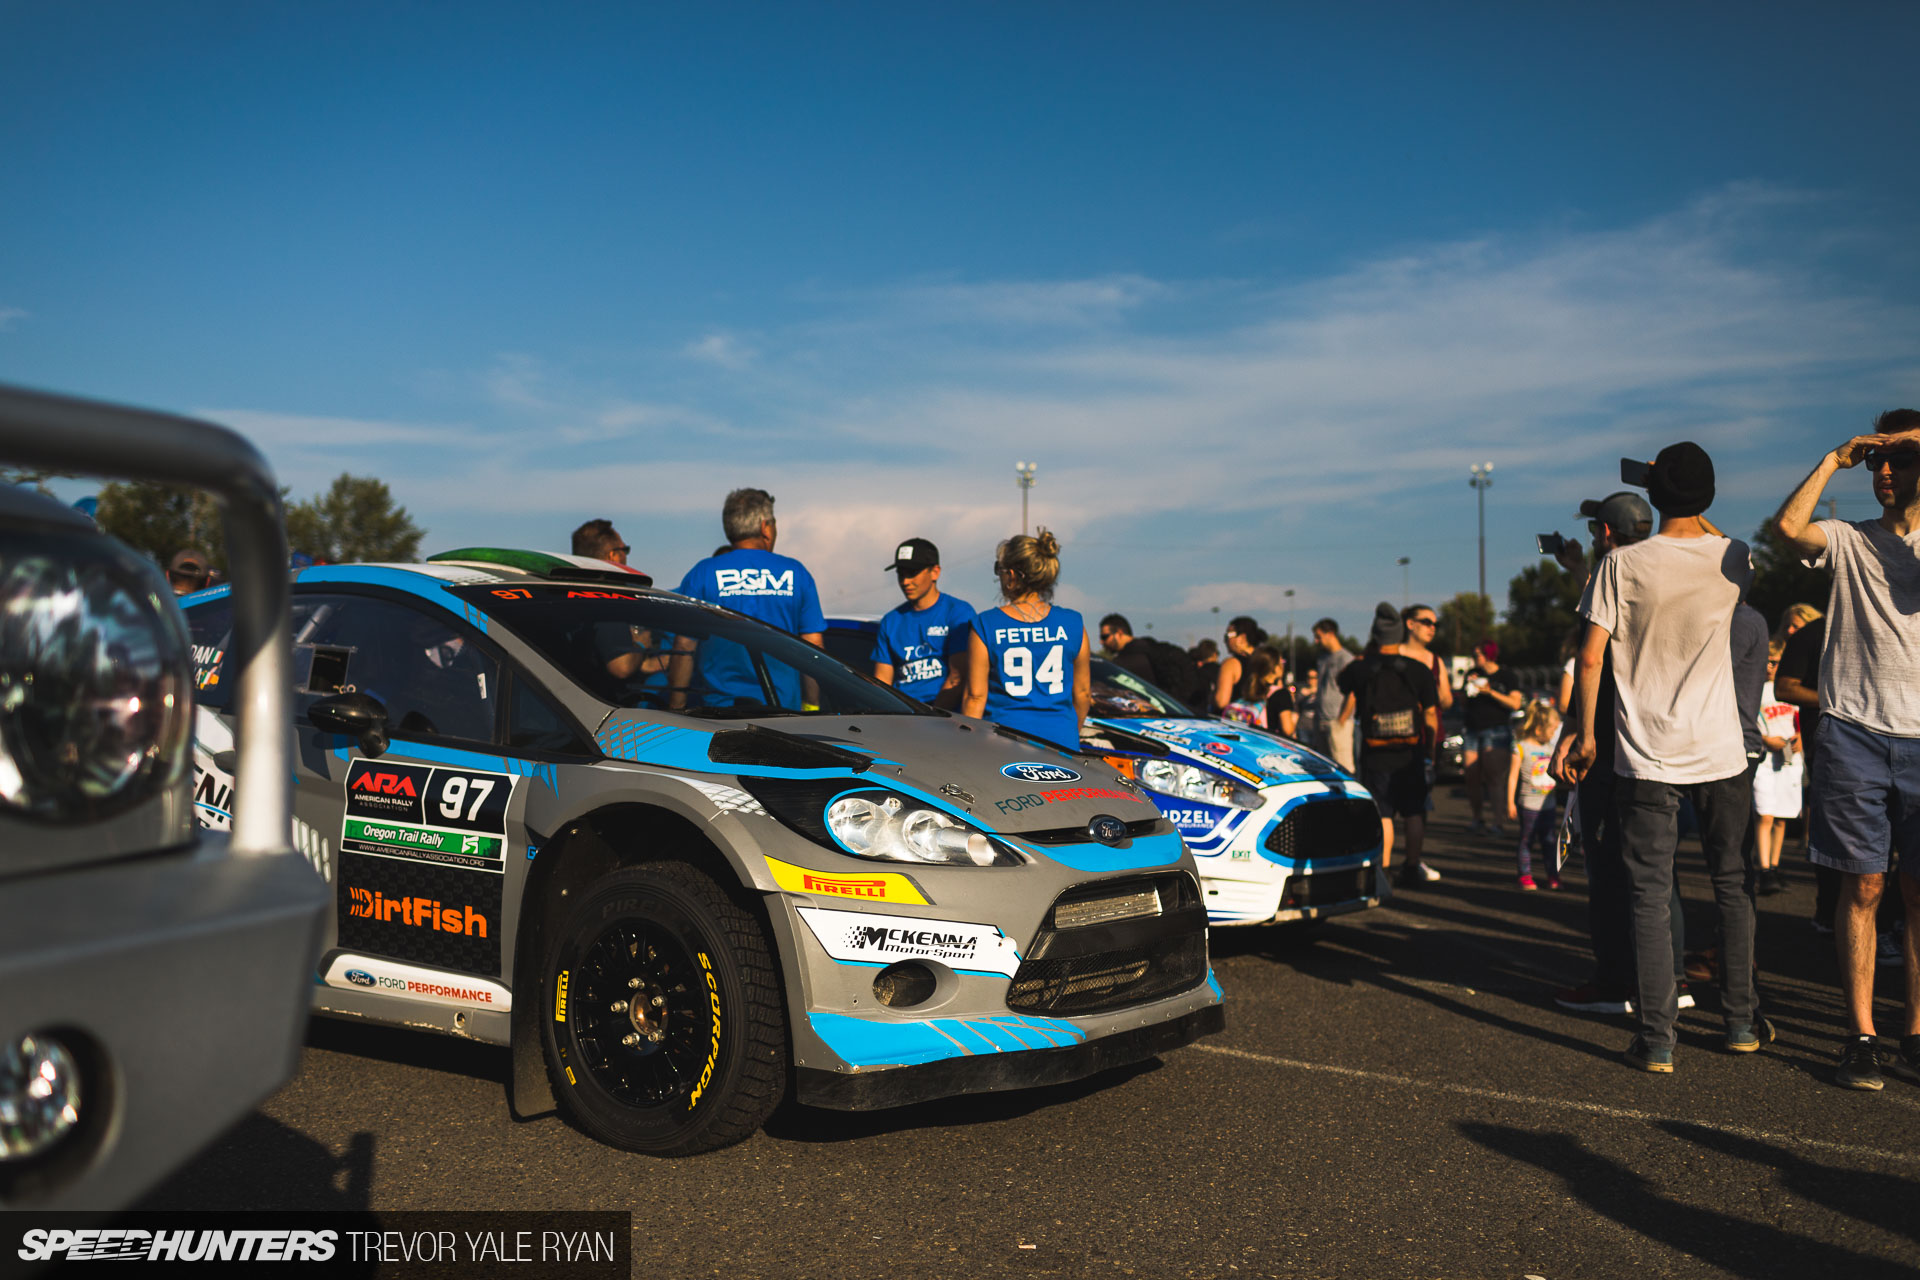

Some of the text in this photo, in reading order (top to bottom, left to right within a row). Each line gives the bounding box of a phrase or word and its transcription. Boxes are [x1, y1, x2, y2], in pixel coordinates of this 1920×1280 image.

[715, 568, 794, 591] B&M
[490, 589, 534, 600] 97
[567, 590, 640, 601] ARA
[995, 625, 1068, 645] FETELA
[1003, 644, 1064, 697] 94
[1016, 763, 1071, 781] Ford
[351, 771, 418, 797] ARA
[354, 793, 414, 807] AMERICAN RALLY
[359, 801, 409, 812] ASSOCIATION
[439, 776, 496, 821] 97
[994, 793, 1045, 815] FORD
[363, 824, 445, 849] Oregon Trail Rally
[1101, 821, 1121, 838] Ford
[358, 843, 486, 867] WWW.AMERICANRALLYASSOCIATION.ORG
[803, 874, 887, 898] PIRELLI
[350, 886, 488, 938] DirtFish
[351, 970, 373, 986] Ford
[378, 976, 493, 1003] FORD PERFORMANCE
[555, 970, 570, 1022] PIRELLI
[688, 952, 721, 1110] SCORPION
